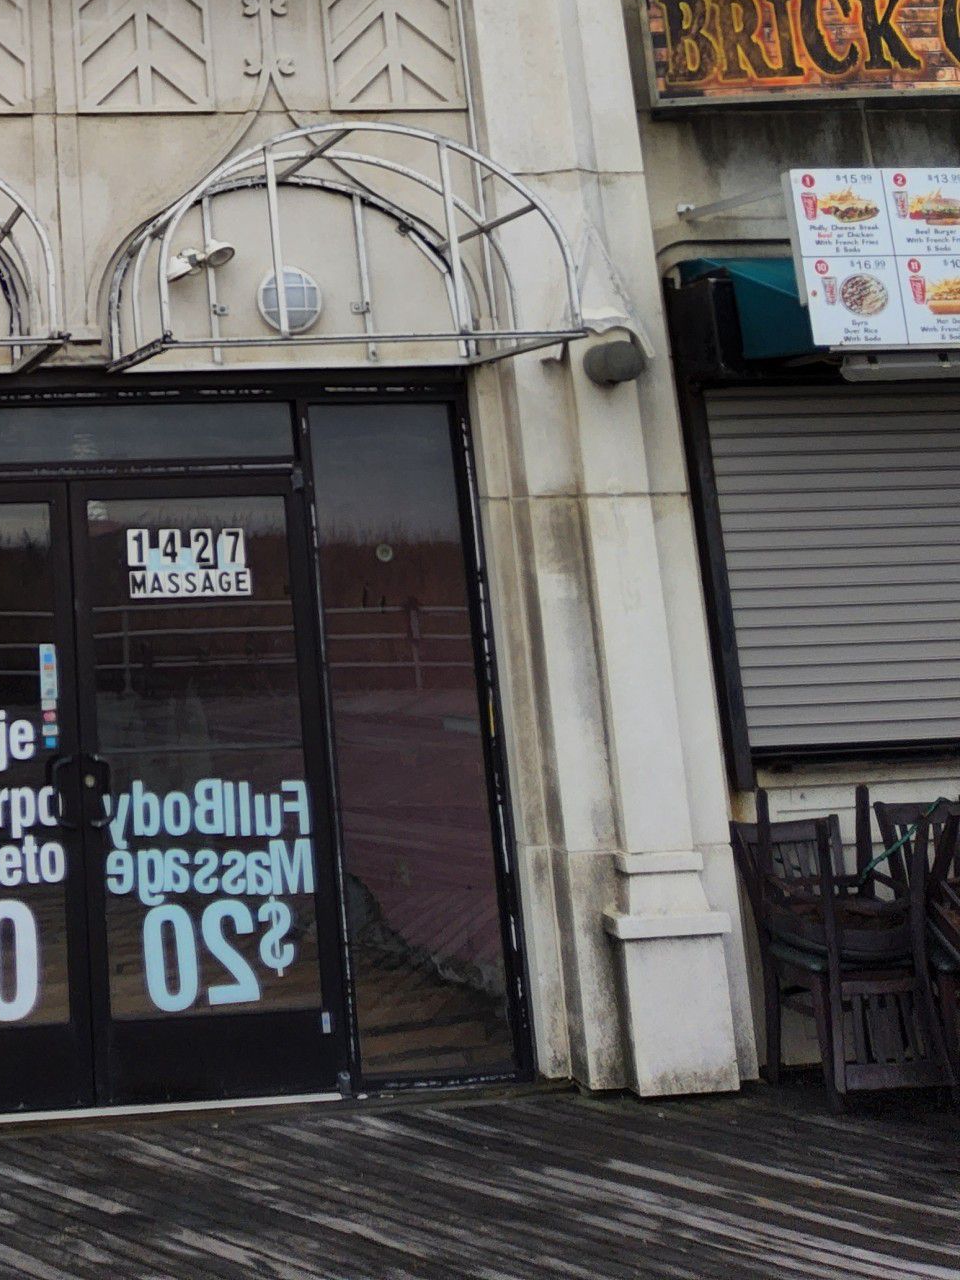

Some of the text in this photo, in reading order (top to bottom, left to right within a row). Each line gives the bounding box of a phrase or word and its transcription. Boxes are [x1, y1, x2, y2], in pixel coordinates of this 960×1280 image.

[934, 228, 957, 236] Burger
[131, 530, 240, 563] 1427
[130, 571, 249, 595] MASSAGE
